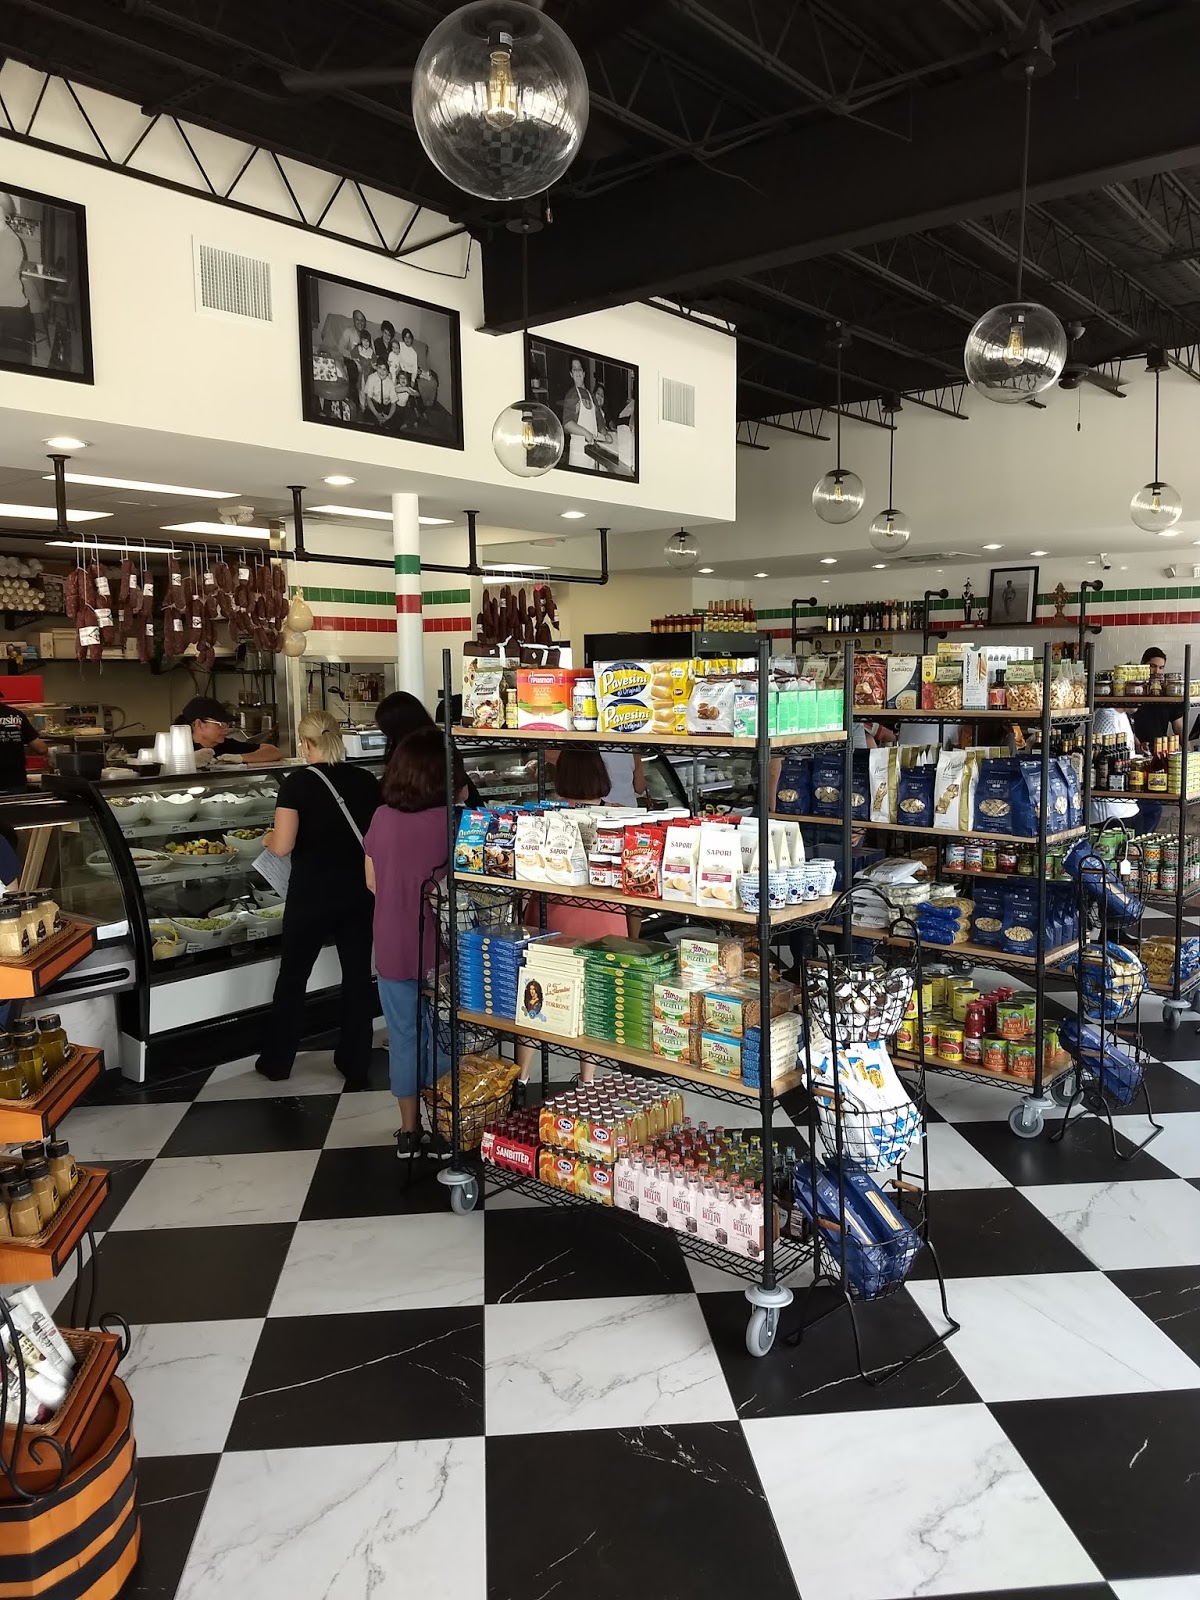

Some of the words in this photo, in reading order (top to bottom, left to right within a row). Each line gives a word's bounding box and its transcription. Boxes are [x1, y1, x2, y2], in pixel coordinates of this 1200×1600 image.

[602, 670, 648, 693] Pavesini
[603, 705, 650, 728] Pavesini
[670, 841, 692, 849] SAPORI
[549, 848, 568, 856] SAPORI
[706, 849, 732, 857] SAPORI
[545, 1001, 570, 1011] TORRONE
[495, 1146, 530, 1165] SANBITTER
